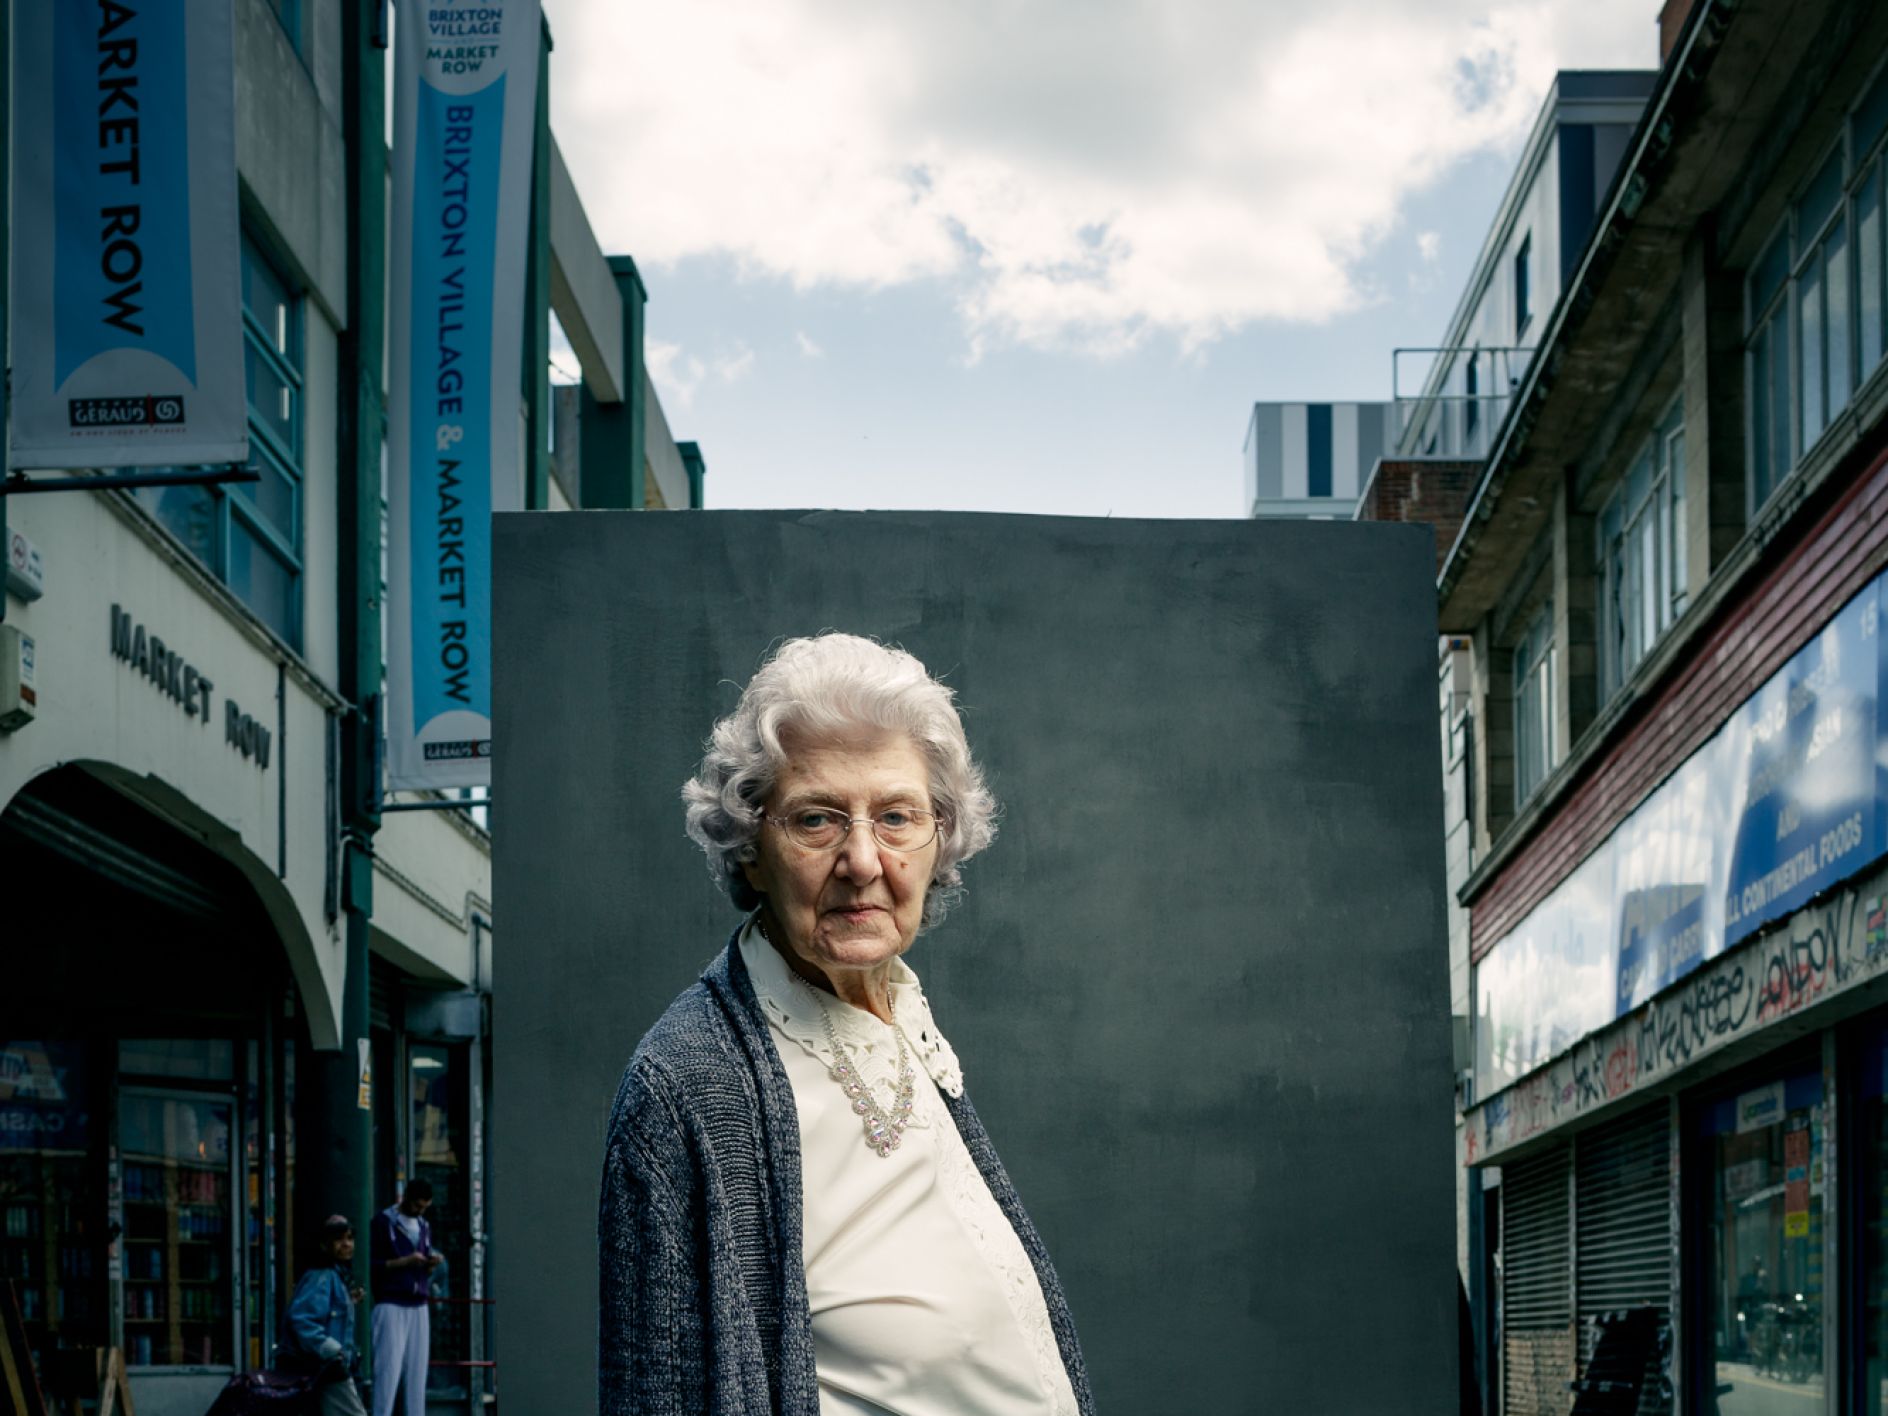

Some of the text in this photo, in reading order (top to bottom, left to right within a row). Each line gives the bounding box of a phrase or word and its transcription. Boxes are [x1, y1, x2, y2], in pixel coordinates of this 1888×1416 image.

[429, 9, 503, 22] BRIXTON
[429, 22, 501, 36] VILLAGE
[426, 45, 499, 60] MARKET
[441, 60, 482, 75] ROW
[97, 0, 144, 337] ARKET ROW
[436, 105, 474, 705] BRIXTON VILLAGE & MARKET ROW
[1859, 598, 1877, 640] 15
[110, 603, 214, 725] MARKET
[224, 698, 271, 770] ROW
[1742, 842, 1818, 917] CONTINENTAL
[1819, 811, 1862, 870] FOODS
